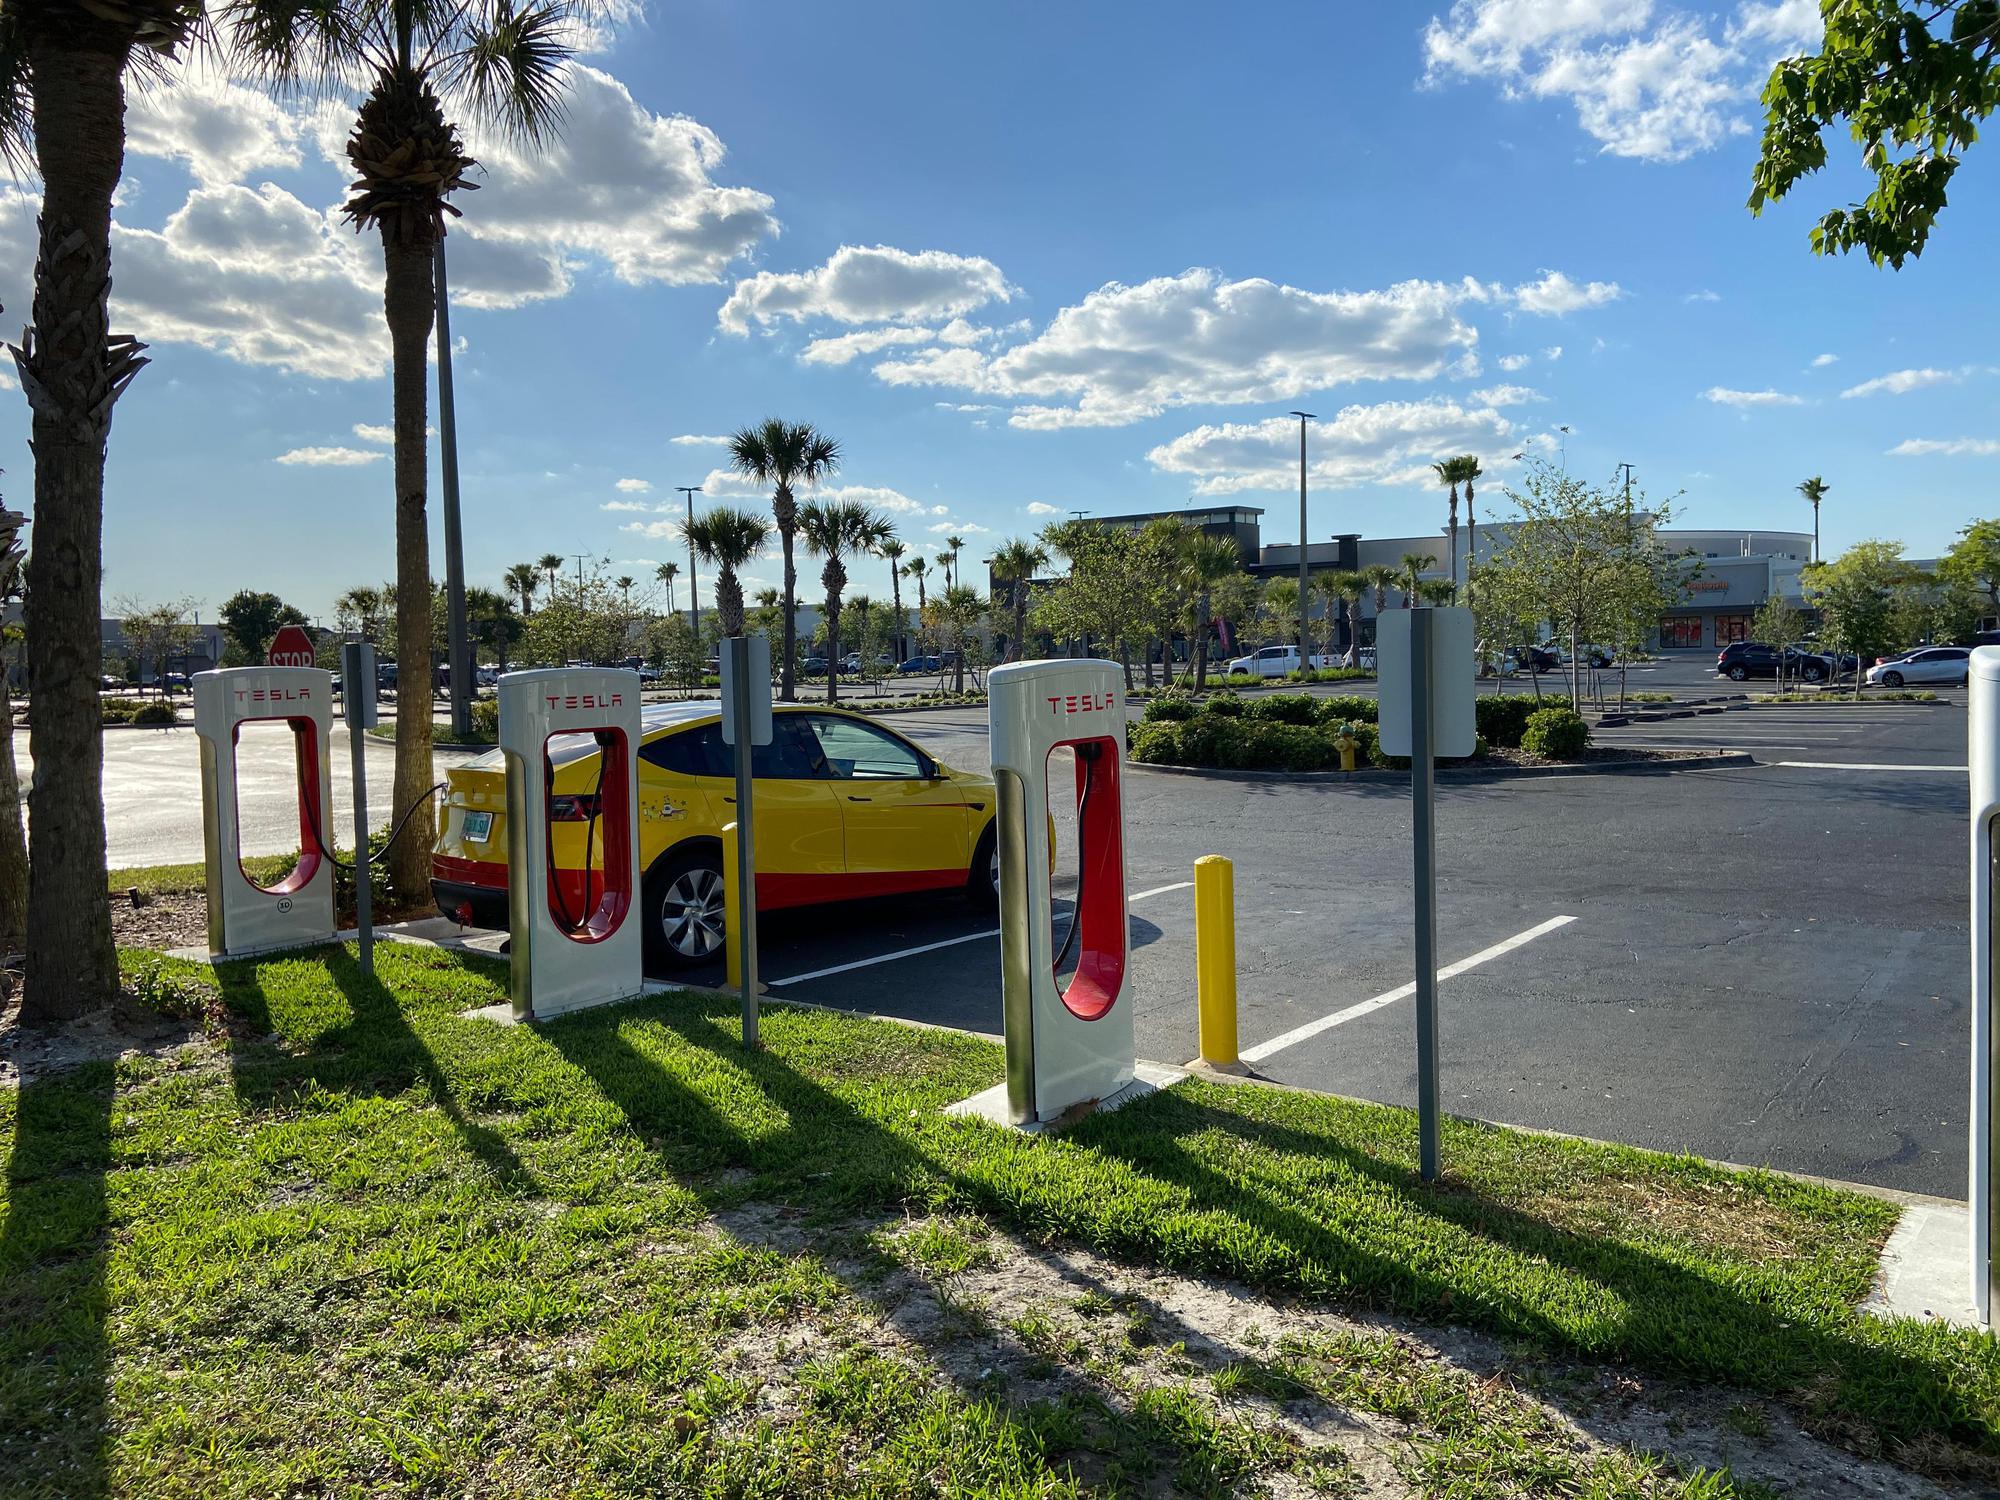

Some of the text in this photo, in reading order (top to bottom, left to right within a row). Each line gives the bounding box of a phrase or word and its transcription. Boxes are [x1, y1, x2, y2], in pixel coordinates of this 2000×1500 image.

[234, 689, 310, 701] TESLA
[546, 694, 622, 710] TESLA
[1047, 693, 1114, 714] TESLA
